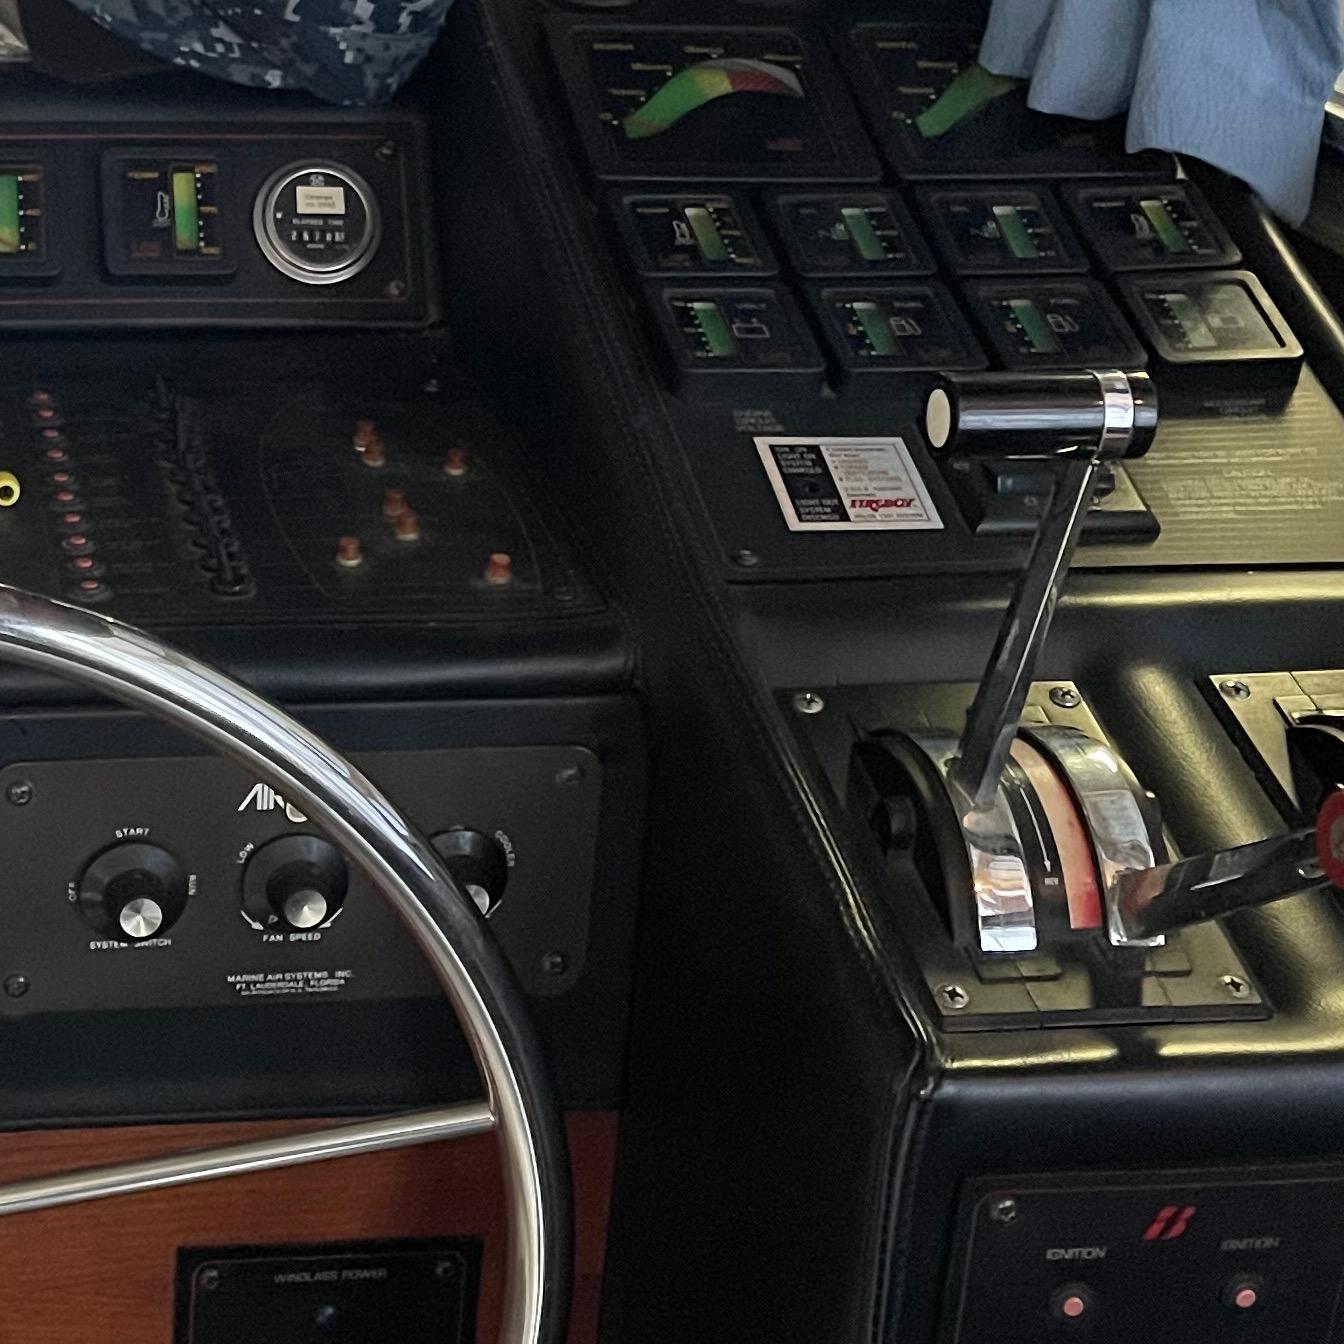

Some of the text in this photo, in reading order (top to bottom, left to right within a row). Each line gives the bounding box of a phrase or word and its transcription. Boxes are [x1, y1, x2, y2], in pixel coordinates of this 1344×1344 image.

[115, 827, 150, 838] START
[236, 842, 255, 864] LOW
[495, 830, 516, 867] COOLER
[188, 874, 197, 896] RUN
[262, 932, 321, 942] FAN SPEED
[227, 973, 265, 983] MARINE
[266, 973, 283, 982] AIR
[284, 970, 329, 981] SYSTEMS
[1220, 1236, 1281, 1252] IGNITION
[1045, 1246, 1108, 1261] IGNITION
[273, 1268, 388, 1283] WINDLASS POWER
